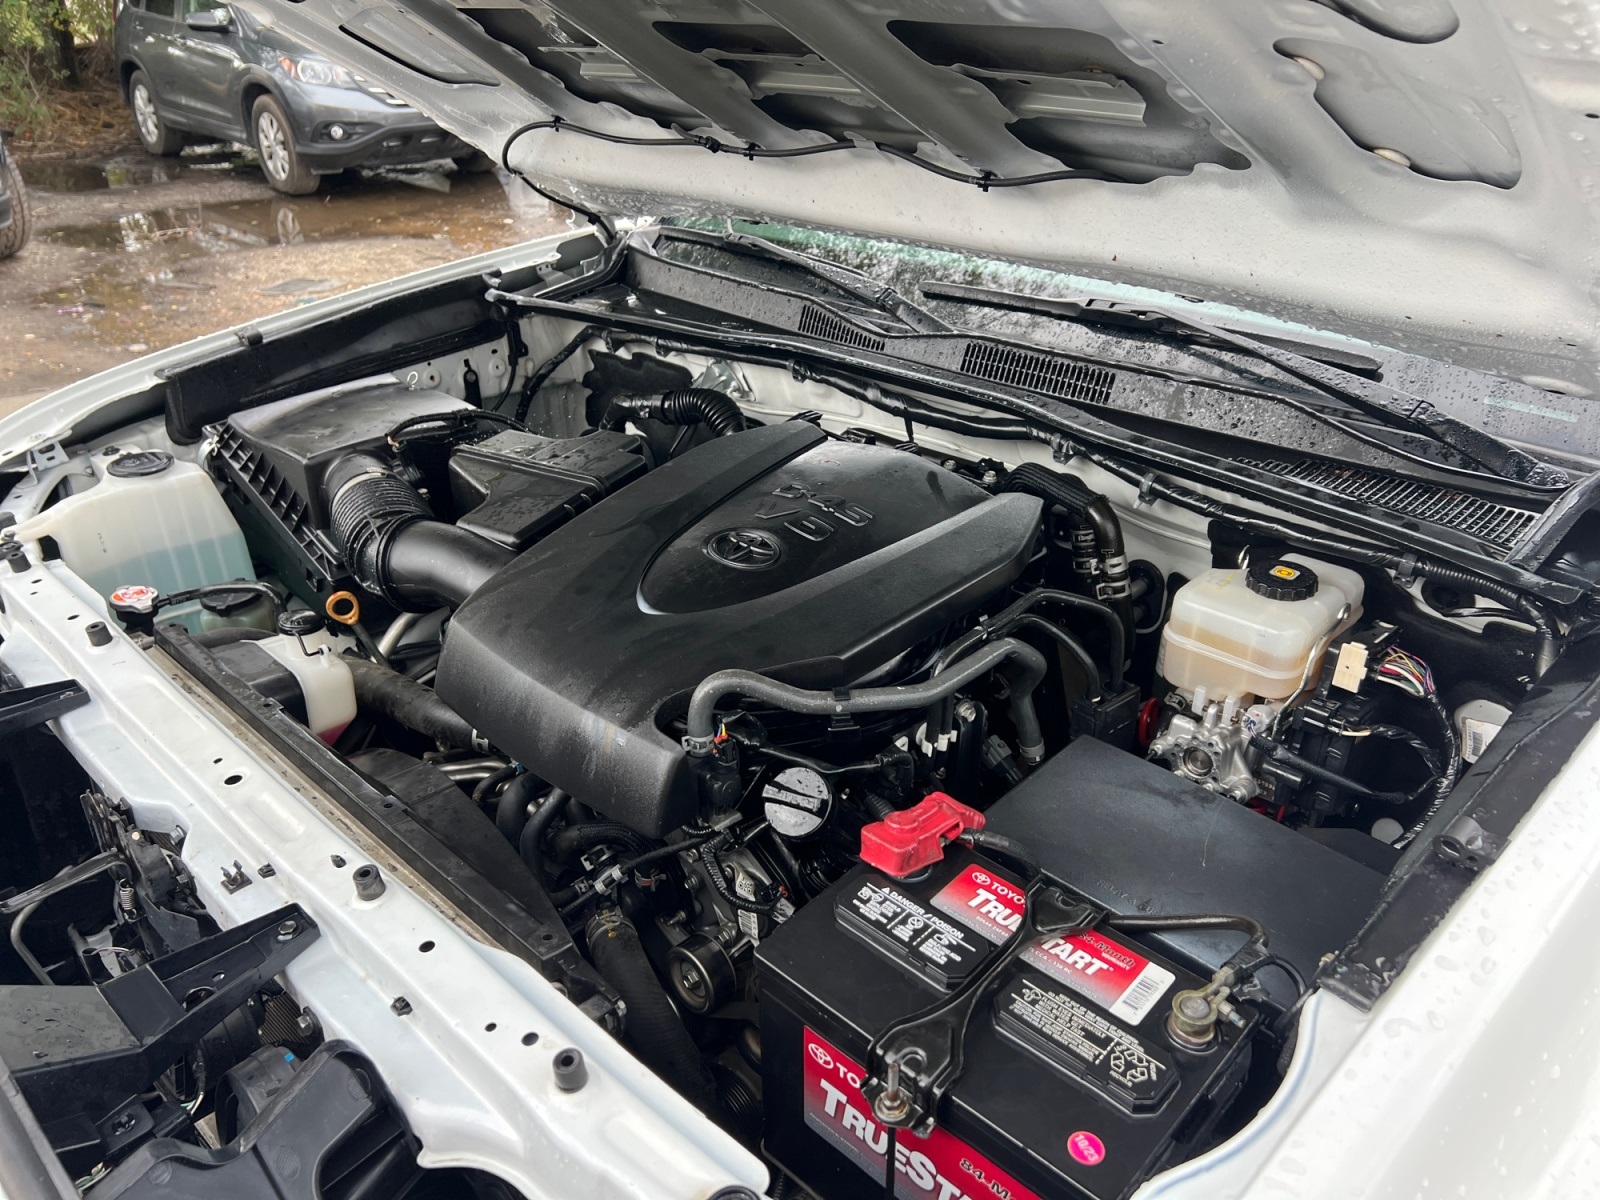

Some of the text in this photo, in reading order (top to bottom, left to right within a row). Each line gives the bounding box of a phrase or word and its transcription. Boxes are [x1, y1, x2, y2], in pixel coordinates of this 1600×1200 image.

[890, 891, 926, 915] DANGER
[929, 916, 964, 940] POISON
[991, 881, 1026, 906] TOYO
[819, 1078, 973, 1200] TRUEST
[959, 1157, 1016, 1200] 84-M
